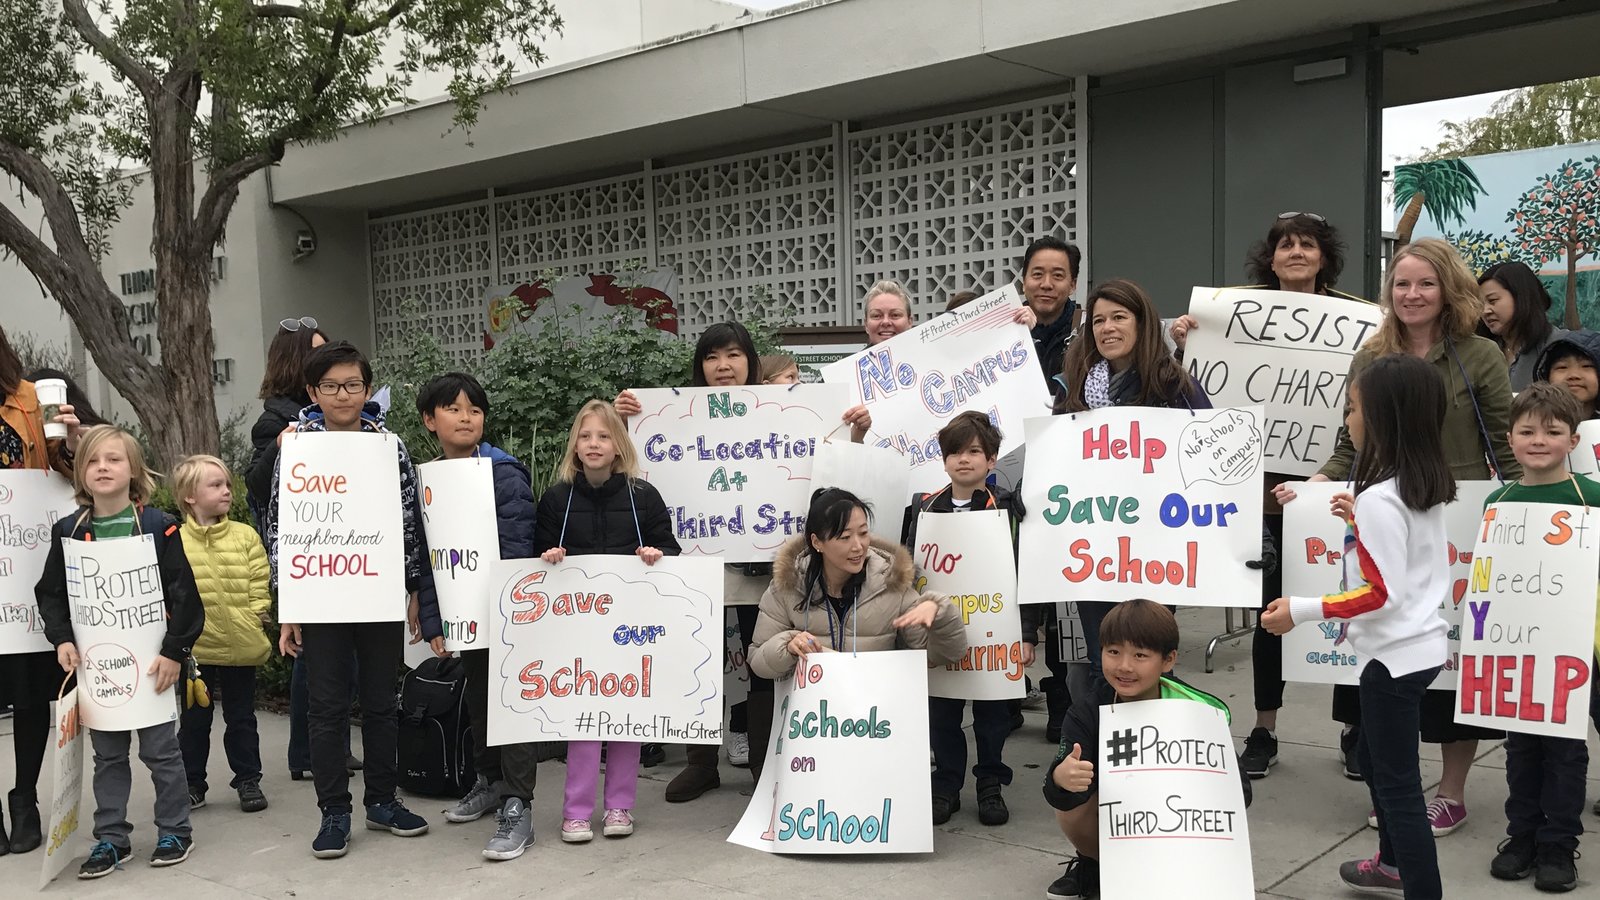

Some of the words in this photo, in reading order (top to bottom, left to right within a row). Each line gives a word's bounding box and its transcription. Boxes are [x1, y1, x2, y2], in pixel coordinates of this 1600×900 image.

[1225, 299, 1377, 351] RESIST
[799, 355, 820, 363] STREET
[1188, 358, 1229, 395] NO
[1246, 364, 1348, 409] CHART
[707, 391, 747, 419] No
[1082, 420, 1167, 474] Help
[1184, 443, 1202, 459] No
[1212, 446, 1227, 460] on
[1264, 418, 1327, 463] ERE
[287, 462, 347, 494] Save
[707, 466, 748, 492] At
[290, 500, 344, 523] YOUR
[1042, 484, 1140, 526] Save
[1159, 492, 1238, 528] Our
[280, 528, 384, 554] neighborhood
[1481, 508, 1528, 546] Third
[1543, 510, 1590, 549] St.
[290, 553, 379, 580] SCHOOL
[1062, 536, 1198, 588] School
[1472, 556, 1564, 596] Needs
[510, 570, 613, 625] Save
[613, 624, 666, 646] our
[1469, 600, 1540, 644] Your
[86, 660, 92, 670] 2
[97, 656, 135, 671] SCHOOLS
[96, 684, 132, 698] CAMPUS
[1461, 654, 1590, 724] HELP
[790, 757, 815, 772] on
